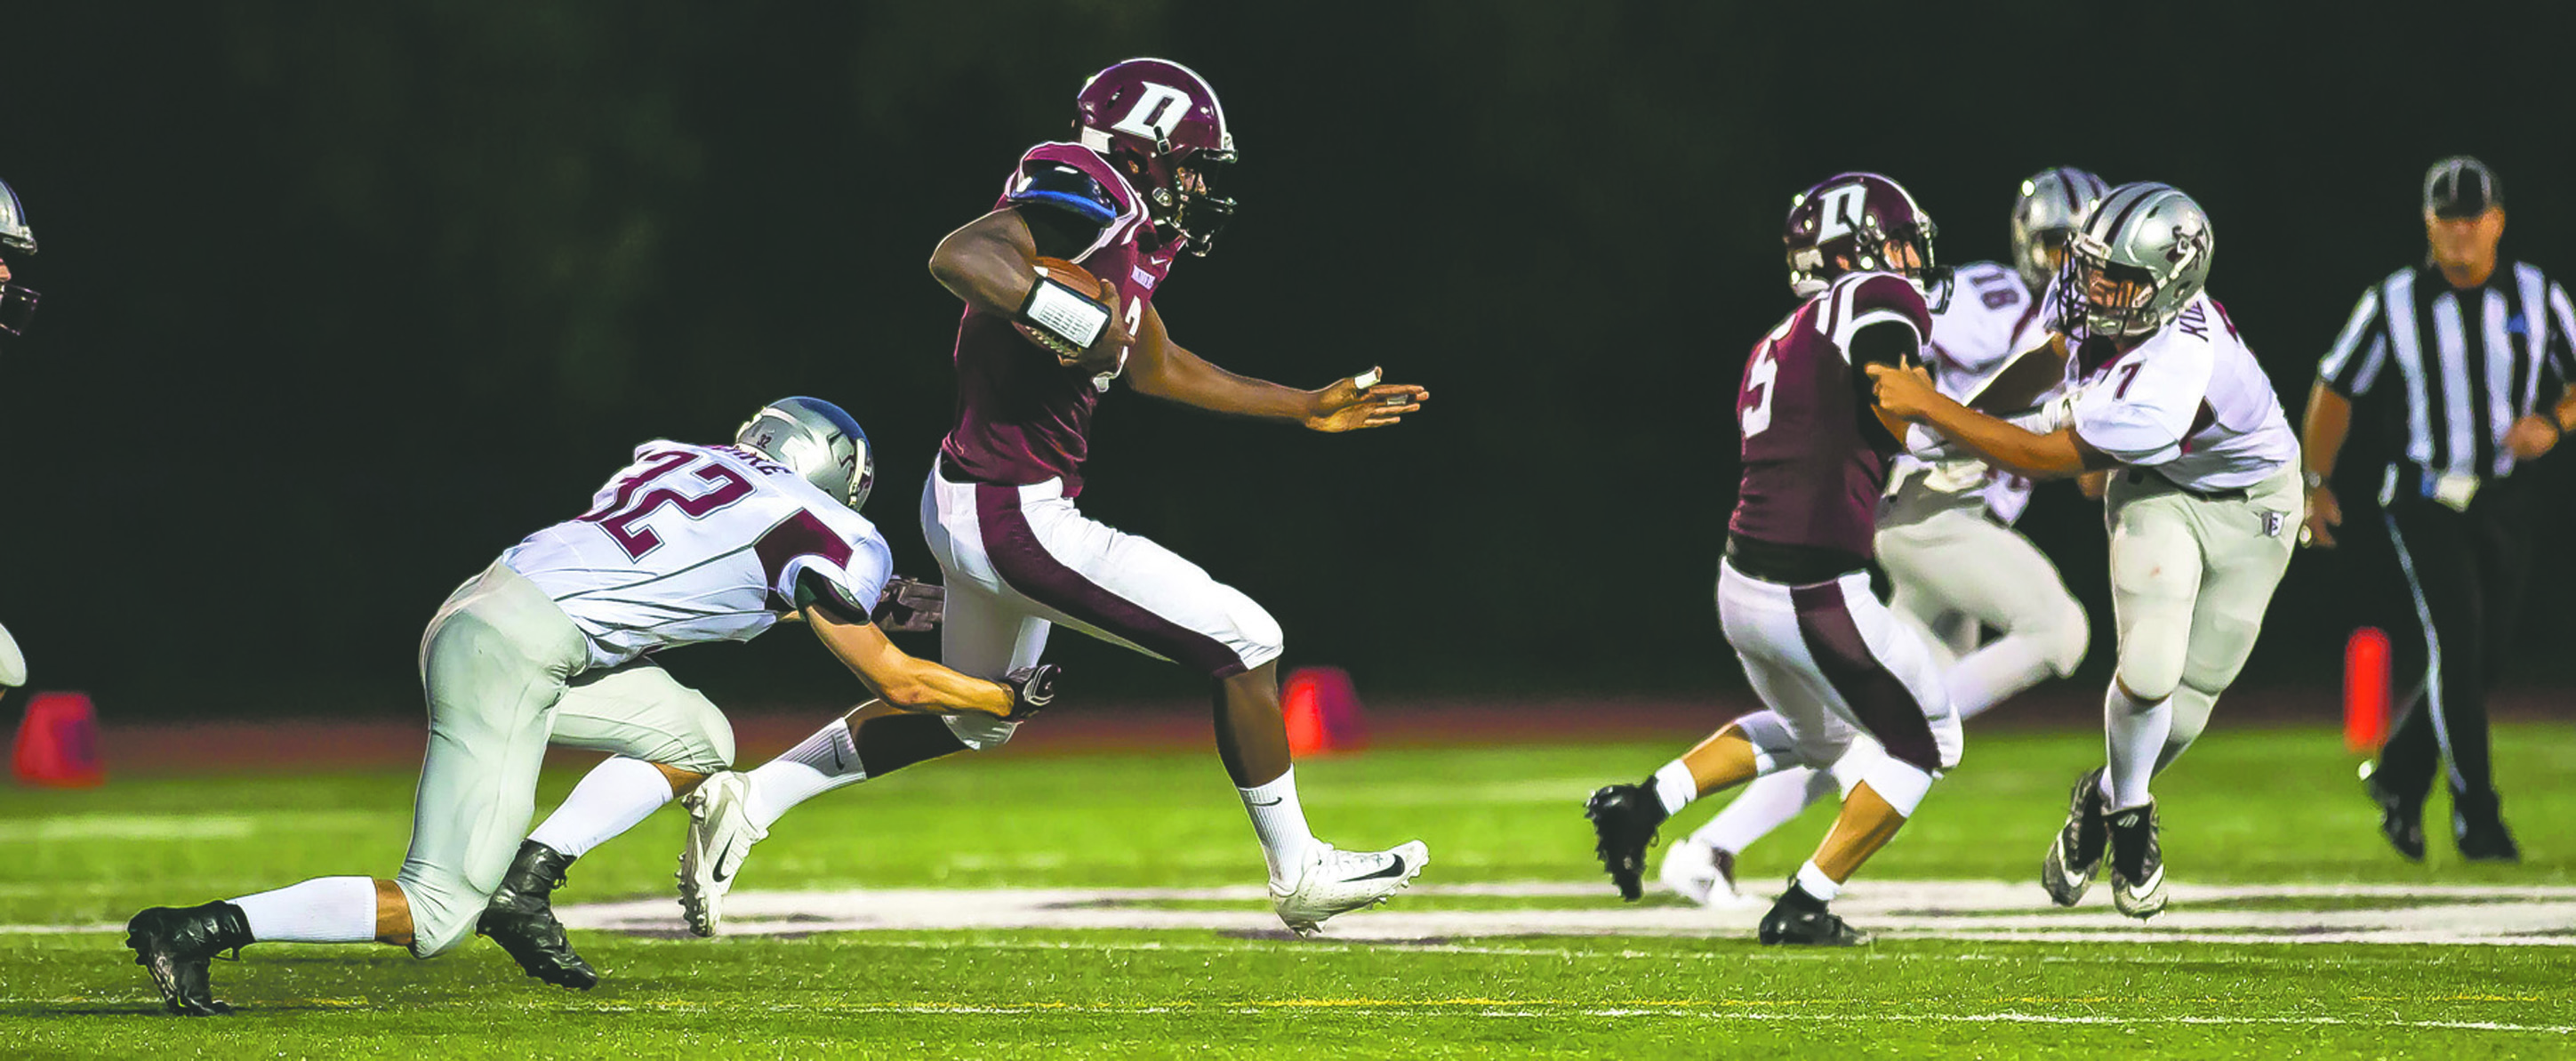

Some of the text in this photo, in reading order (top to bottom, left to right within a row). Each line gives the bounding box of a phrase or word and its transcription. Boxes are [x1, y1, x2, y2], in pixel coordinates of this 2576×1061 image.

[1111, 81, 1193, 141] D
[1816, 183, 1867, 245] D
[1743, 313, 1796, 439] 5
[2115, 360, 2145, 400] 7
[579, 450, 756, 562] 32
